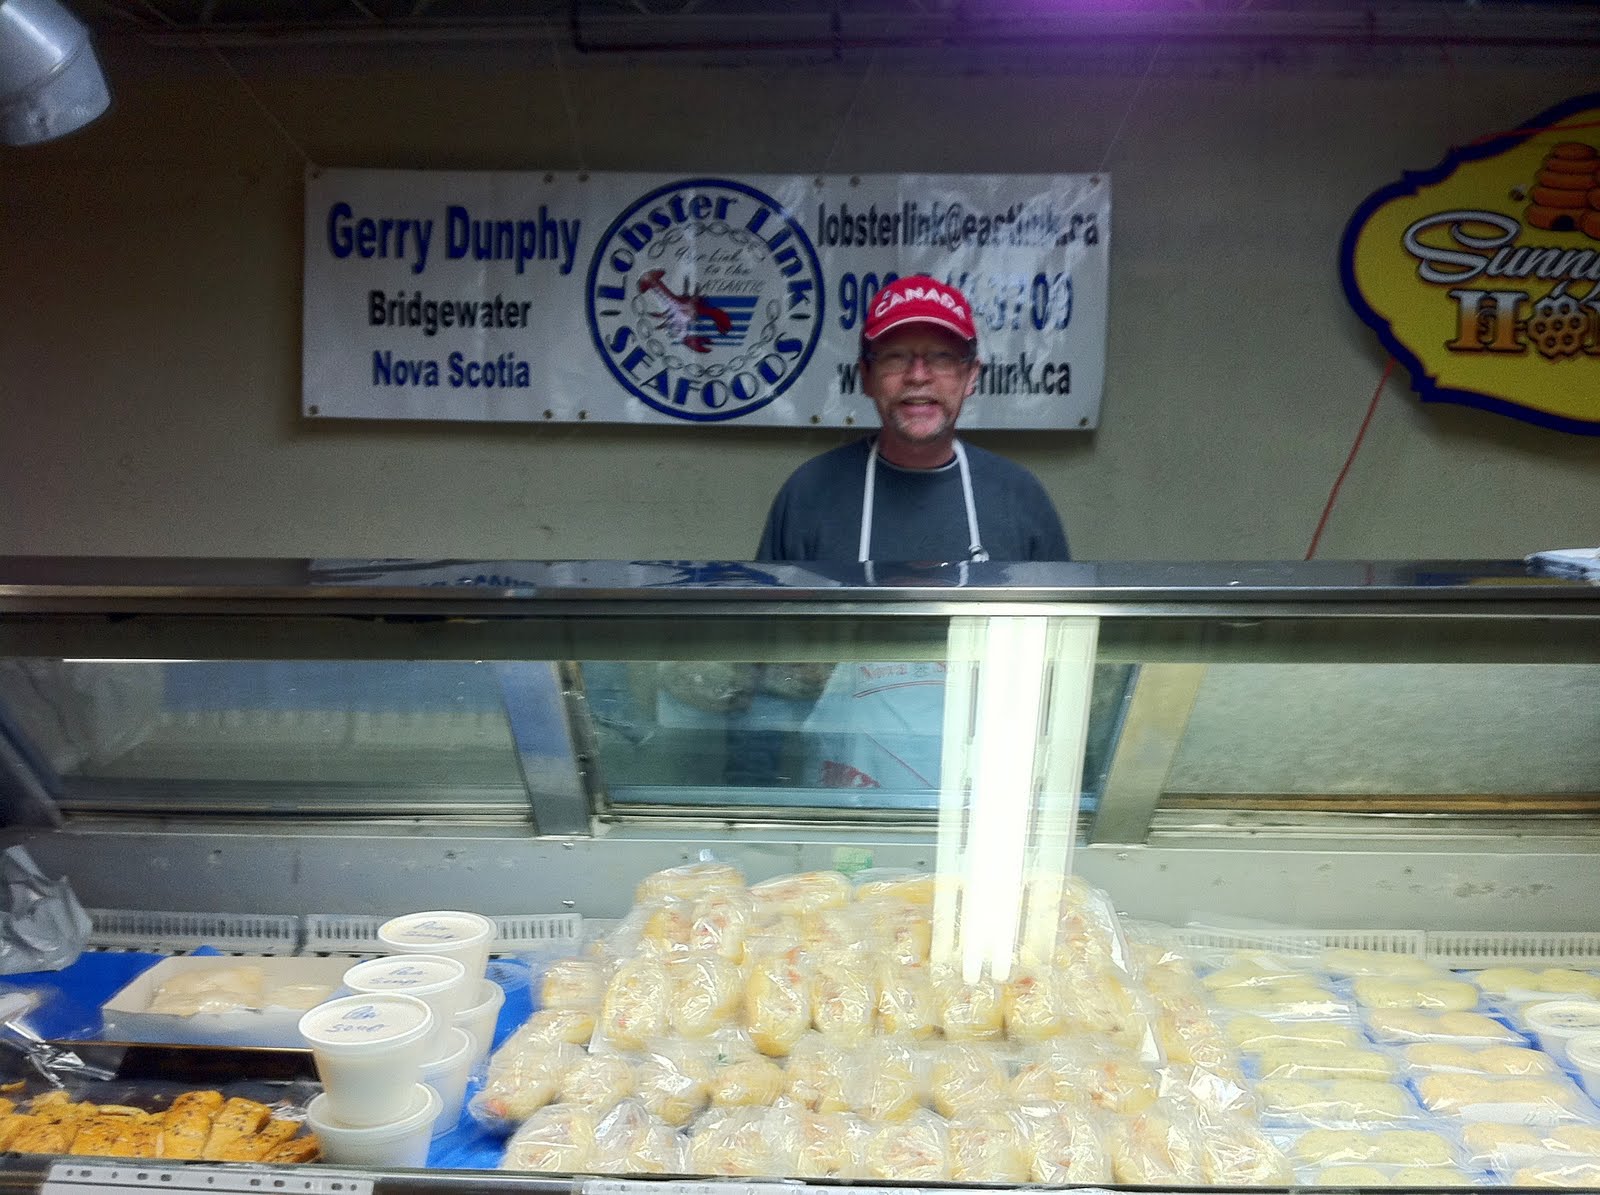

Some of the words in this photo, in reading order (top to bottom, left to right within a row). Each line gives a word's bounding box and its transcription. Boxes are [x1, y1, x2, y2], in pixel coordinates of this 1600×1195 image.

[327, 201, 434, 275] Gerry
[445, 204, 581, 275] Dunphy
[1403, 209, 1600, 284] Sunn
[368, 290, 533, 336] Bridgewater
[875, 286, 966, 321] CANADA
[372, 350, 439, 388] Nova
[448, 350, 531, 389] Scotia
[604, 325, 804, 409] SEAFOODS
